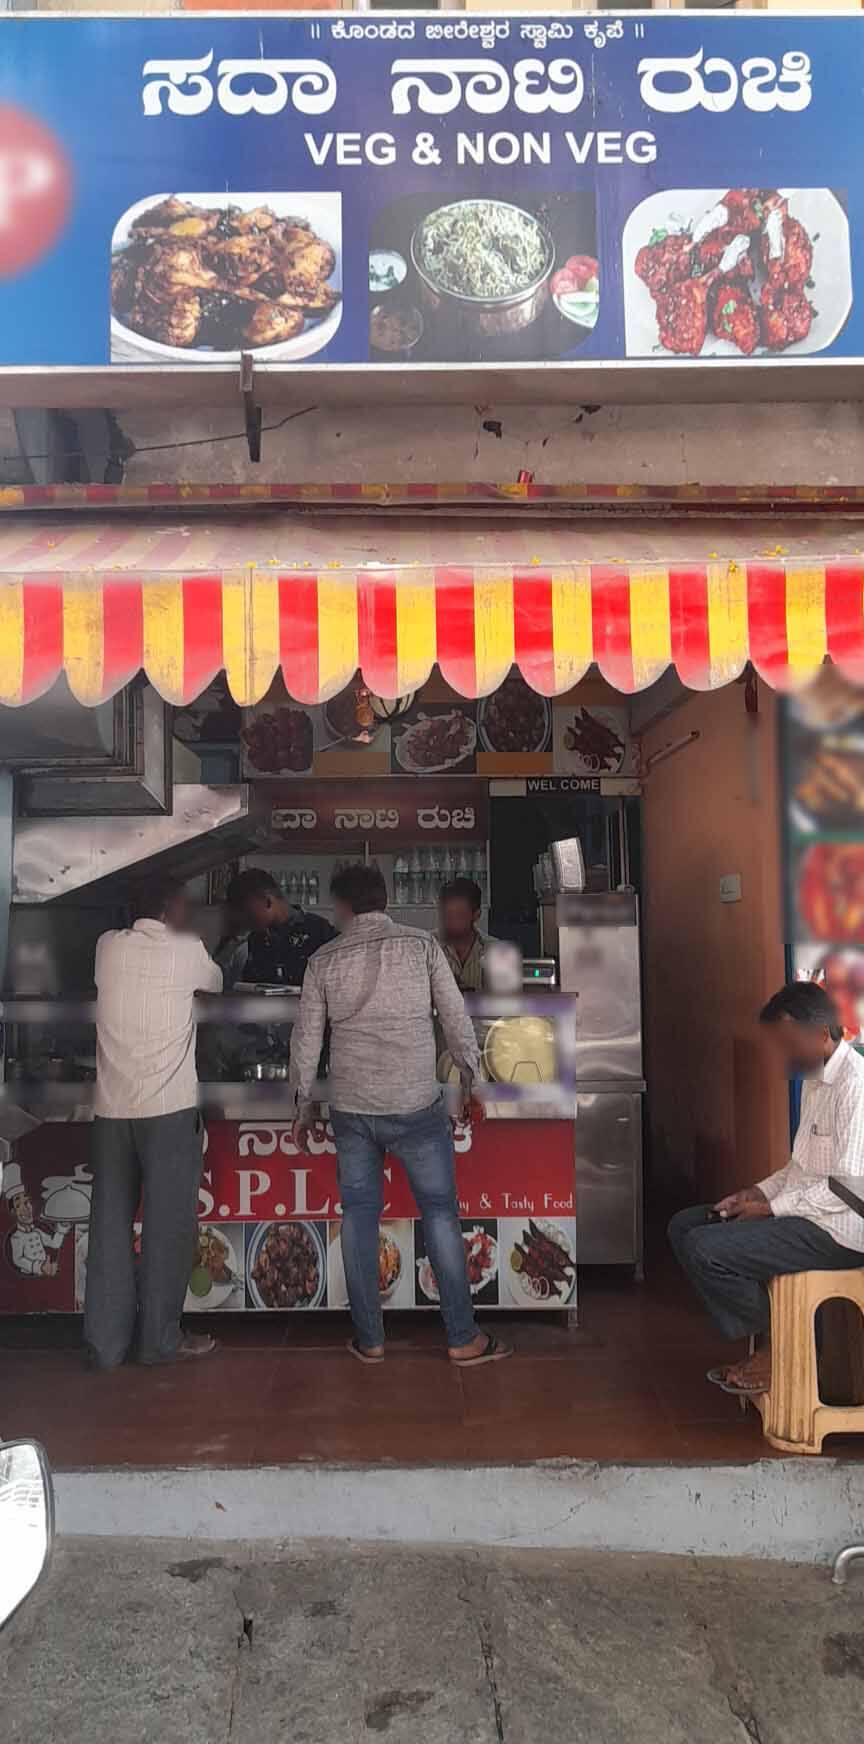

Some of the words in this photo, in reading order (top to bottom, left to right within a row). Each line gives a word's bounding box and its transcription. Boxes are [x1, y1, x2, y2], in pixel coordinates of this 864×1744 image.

[331, 20, 416, 40] ಕೊಂಡದ
[520, 22, 574, 49] ಸ್ವಾಮಿ
[584, 20, 624, 49] ಕೃಪೆ
[142, 48, 337, 116] ಸದಾ
[391, 58, 584, 115] ನಾಟಿ
[637, 47, 812, 113] ರುಚಿ
[304, 131, 397, 166] VEG
[411, 131, 442, 166] &
[457, 131, 550, 165] NON
[565, 130, 657, 165] VEG
[527, 779, 557, 791] WEL
[560, 779, 600, 791] COME
[333, 807, 400, 830] ನಾಟಿ
[416, 804, 476, 830] ರುಚಿ
[479, 1192, 493, 1210] &
[502, 1192, 535, 1213] Tasty
[543, 1192, 574, 1210] Food
